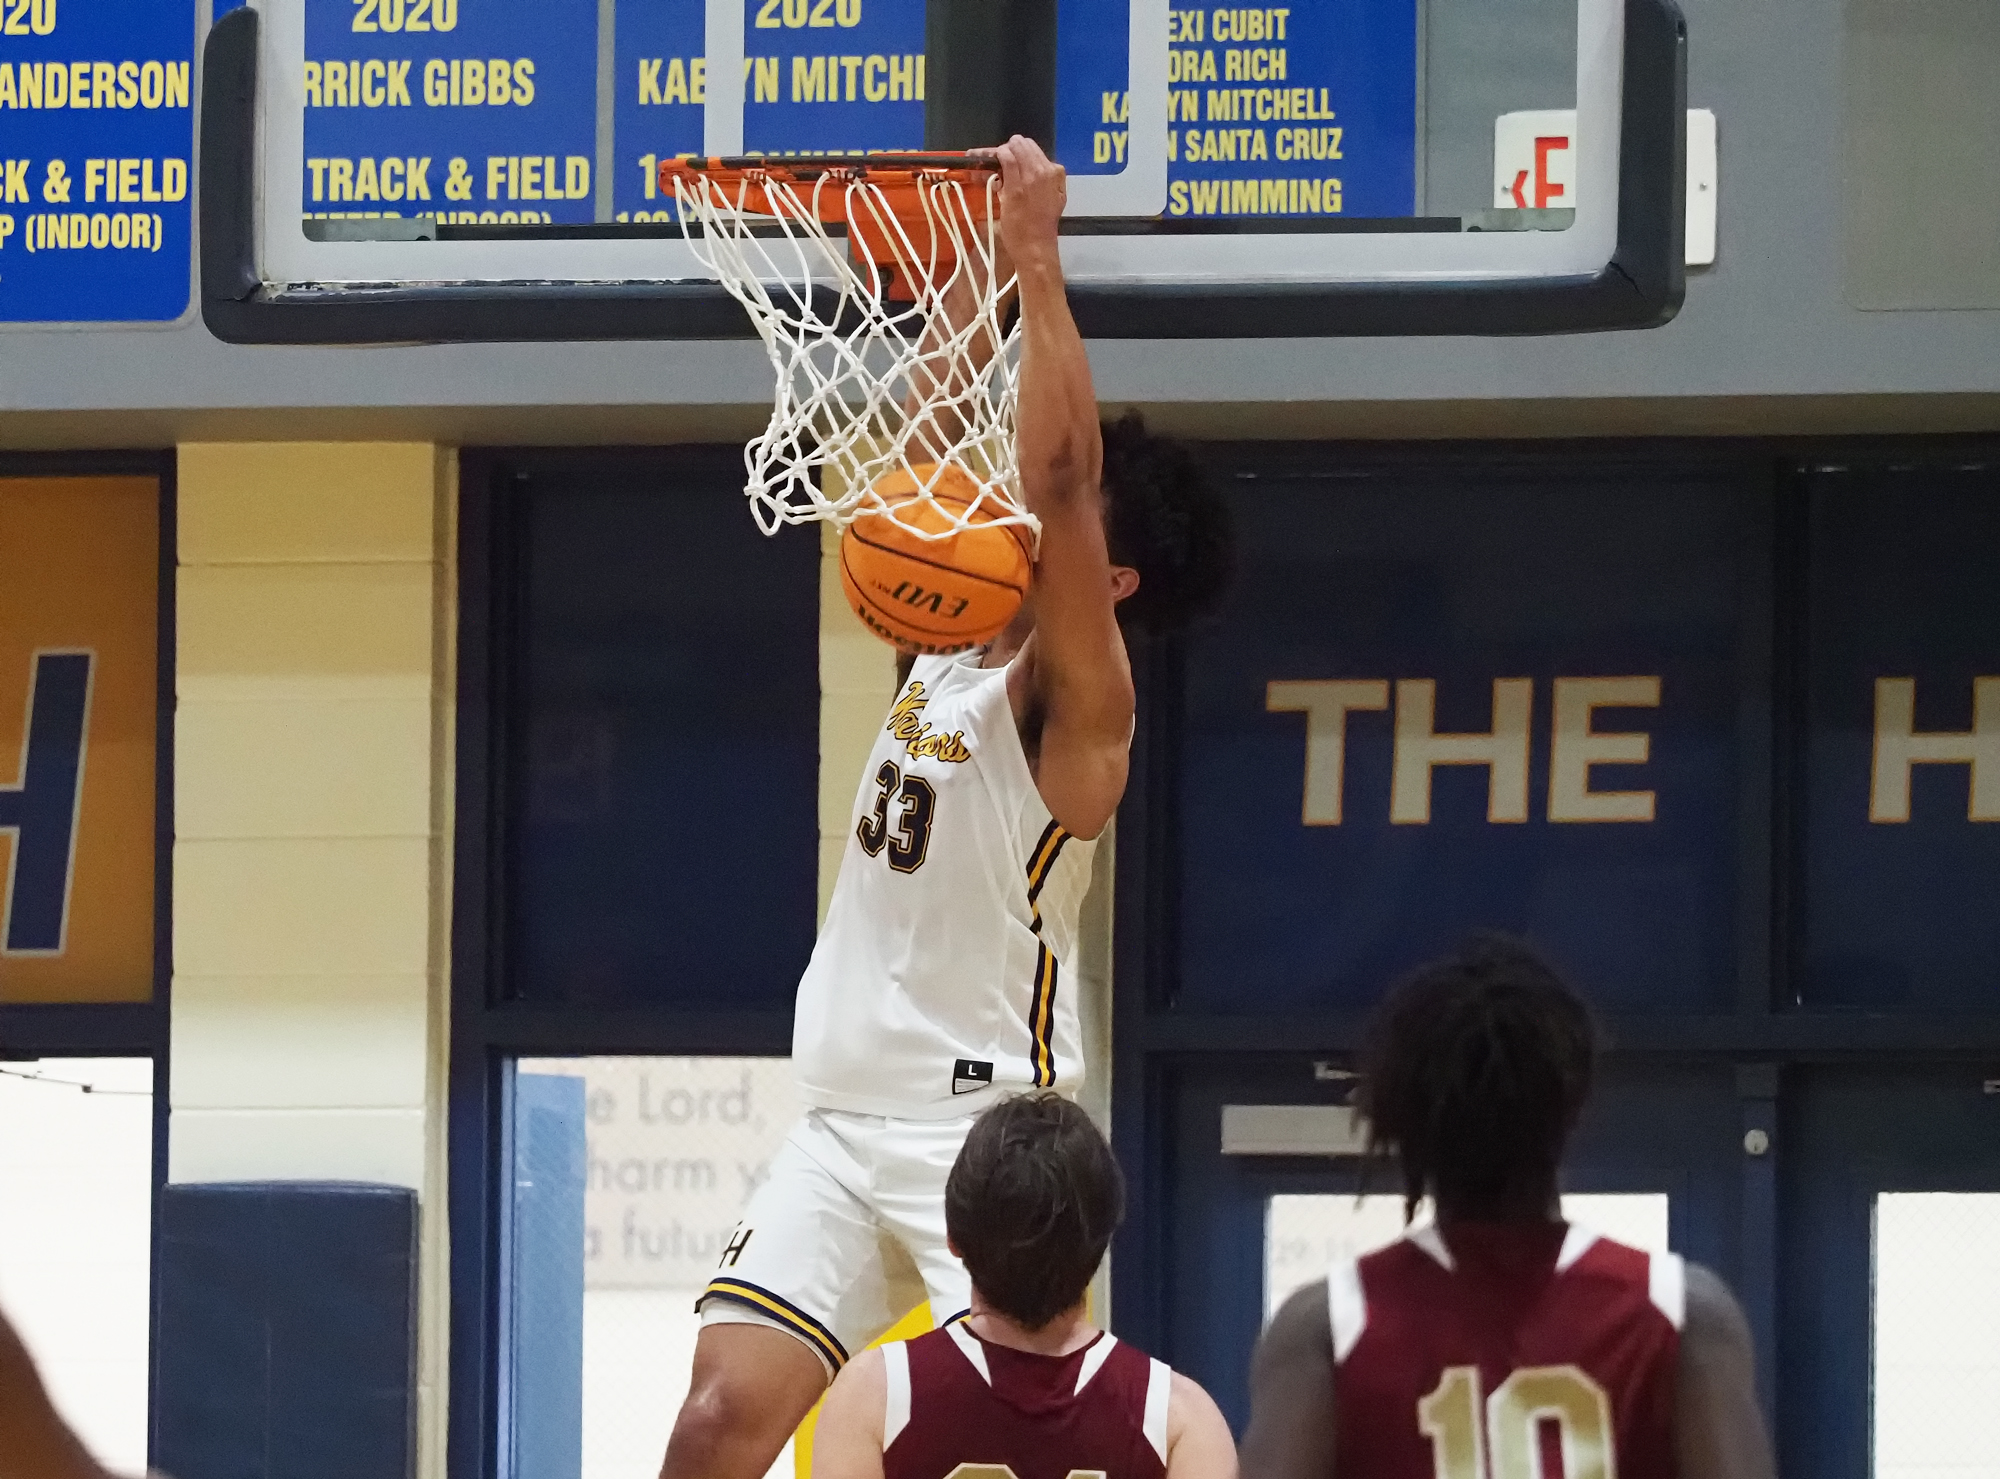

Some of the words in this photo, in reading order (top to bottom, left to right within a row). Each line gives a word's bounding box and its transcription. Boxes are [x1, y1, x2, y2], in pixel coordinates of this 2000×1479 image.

[0, 0, 57, 35] 20
[352, 0, 458, 33] 2020
[754, 0, 862, 28] 2020
[1212, 9, 1290, 42] CUBIT
[424, 58, 535, 106] GIBBS
[1225, 48, 1287, 81] RICH
[0, 61, 189, 109] ANDERSON
[1207, 88, 1335, 121] MITCHELL
[1185, 128, 1269, 162] SANTA
[1276, 127, 1343, 160] CRUZ
[43, 159, 71, 203] &
[85, 157, 187, 202] FIELD
[307, 157, 431, 202] TRACK
[444, 157, 473, 200] &
[487, 156, 590, 200] FIELD
[1169, 179, 1342, 216] SWIMMING
[25, 212, 162, 253] (INDOOR)
[1266, 675, 1662, 826] THE
[856, 759, 936, 875] 33
[967, 1064, 977, 1076] L
